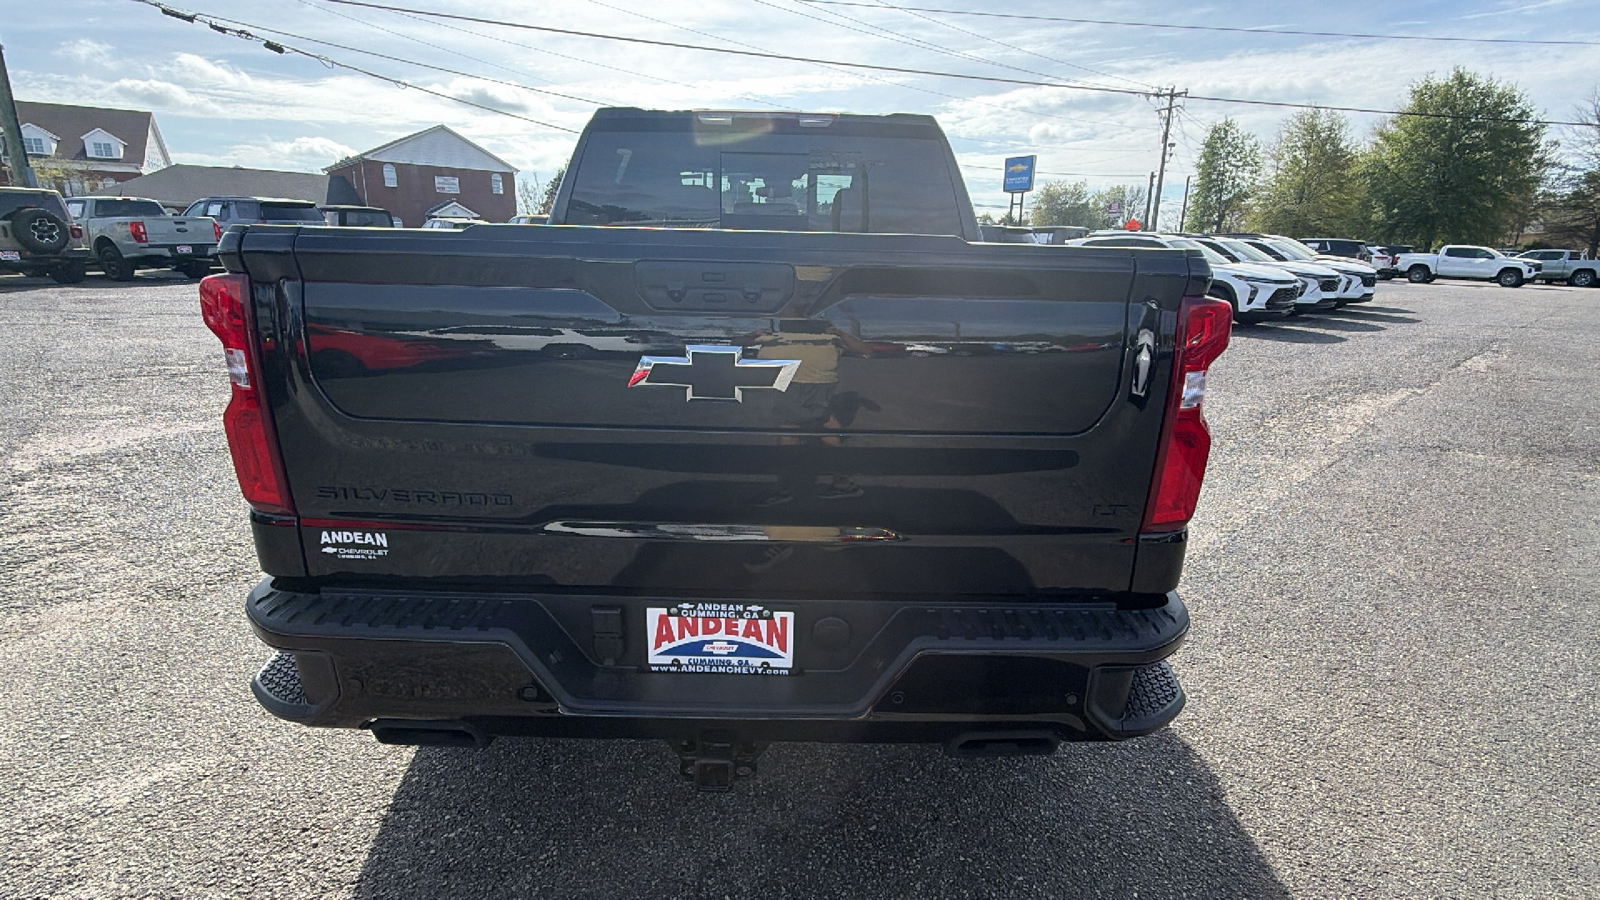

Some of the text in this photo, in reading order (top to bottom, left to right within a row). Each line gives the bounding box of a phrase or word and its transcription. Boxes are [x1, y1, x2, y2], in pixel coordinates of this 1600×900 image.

[316, 486, 513, 506] SILVERADO
[320, 530, 388, 548] ANDEAN
[338, 548, 389, 556] CHEVROLET
[696, 603, 744, 612] ANDEAN
[681, 610, 759, 619] CUMMING, GA
[653, 613, 788, 654] ANDEAN
[687, 658, 736, 667] CUMMING,
[650, 665, 789, 676] www.ANDEANCHEVY.com
